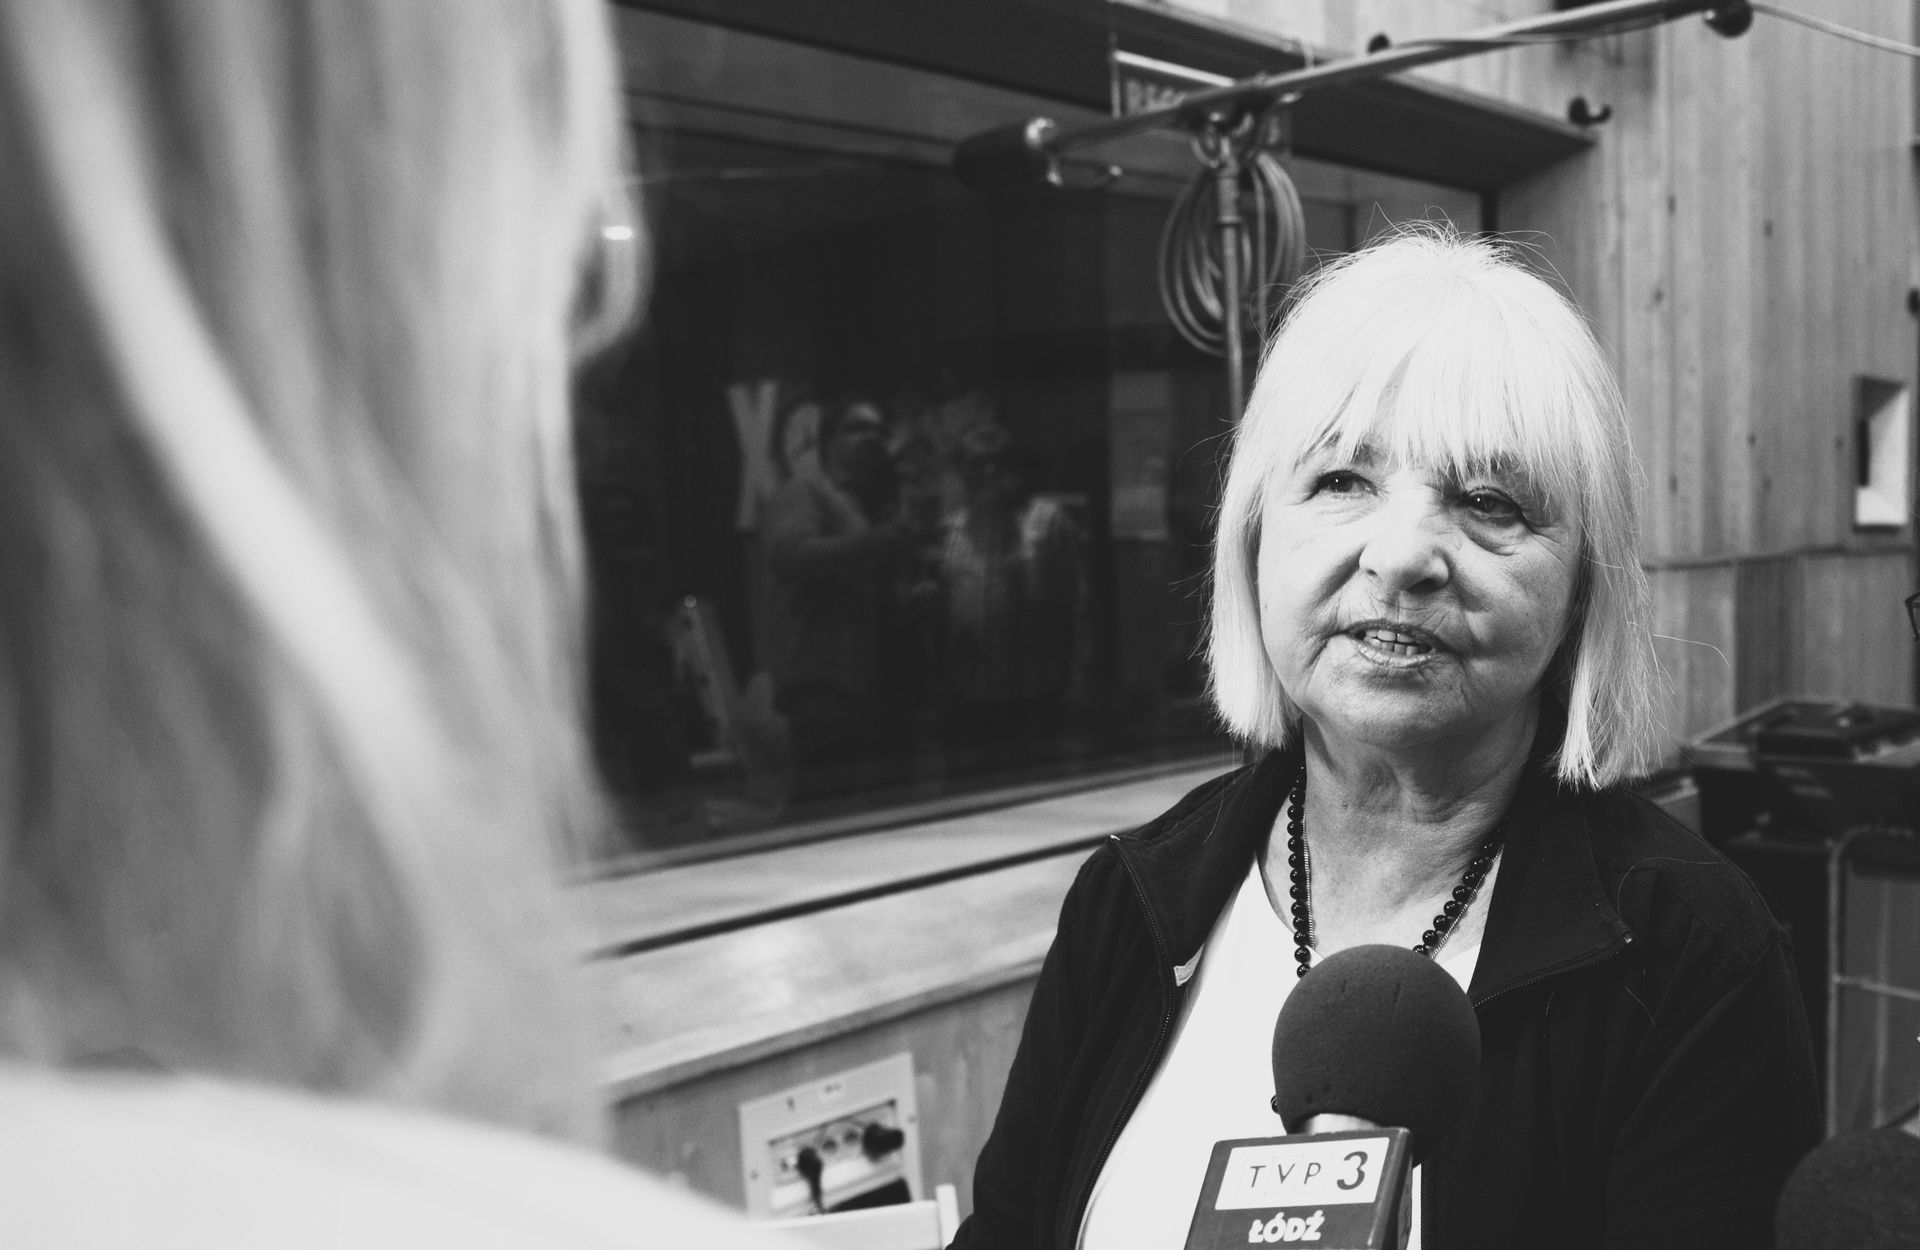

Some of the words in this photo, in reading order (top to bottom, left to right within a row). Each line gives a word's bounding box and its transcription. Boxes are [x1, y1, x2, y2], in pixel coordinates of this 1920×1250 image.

[1249, 1162, 1322, 1188] TVP
[1336, 1151, 1369, 1190] 3
[1248, 1210, 1325, 1243] ŁÓDŹ
